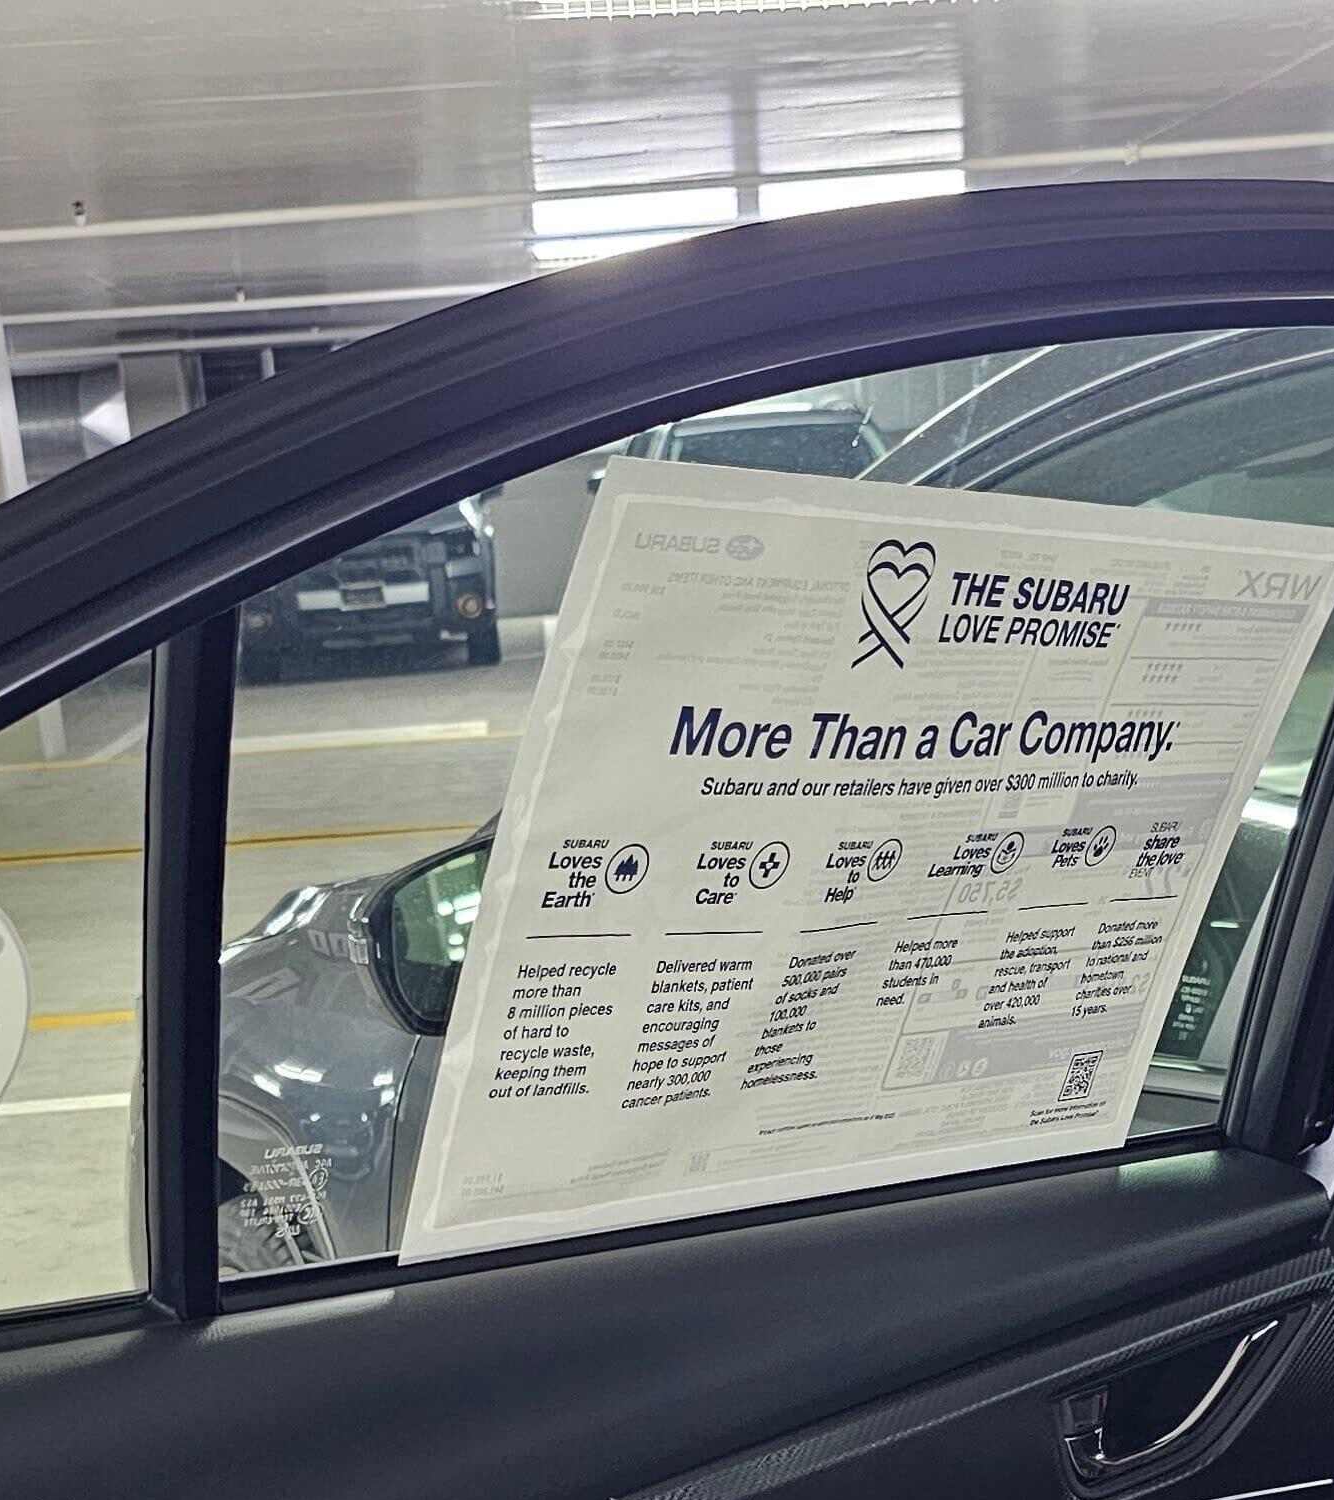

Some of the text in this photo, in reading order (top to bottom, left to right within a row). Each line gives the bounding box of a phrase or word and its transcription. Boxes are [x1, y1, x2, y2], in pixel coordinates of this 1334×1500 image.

[951, 572, 1010, 608] THE
[1013, 576, 1130, 616] SUBARU
[938, 613, 1116, 648] LOVE PROMISE
[669, 705, 1176, 763] More Than a Car Company.
[701, 769, 1138, 798] Subaru and our retailers have given over $300 million to charity.
[562, 839, 610, 850] SUBARU
[710, 840, 754, 851] SUBARU
[838, 840, 874, 851] SUBARU
[965, 832, 999, 844] SUBARU
[1050, 838, 1086, 855] Loves
[1143, 834, 1181, 851] share
[548, 851, 604, 870] Loves
[696, 853, 747, 870] Loves
[825, 853, 867, 869] Loves
[953, 845, 991, 861] Loves
[1051, 854, 1079, 868] Pets
[1135, 850, 1185, 868] the love
[847, 870, 860, 884] to
[927, 860, 984, 879] Learning
[568, 872, 597, 889] the
[723, 872, 740, 888] to
[541, 891, 592, 909] Earth
[695, 888, 735, 905] Care
[824, 885, 854, 904] Help
[1006, 926, 1076, 944] Helped support
[1097, 919, 1159, 934] Donated more
[894, 939, 958, 955] Helped more
[1091, 938, 1112, 951] than
[788, 950, 857, 970] Donated over
[1000, 948, 1015, 960] the
[1086, 956, 1095, 968] to
[1132, 949, 1150, 962] and
[517, 962, 617, 982] Helped recycle
[656, 958, 753, 974] Delivered warm
[888, 959, 912, 971] than
[994, 958, 1071, 978] rescue, transport
[821, 966, 848, 983] pairs
[882, 973, 939, 989] students in
[1080, 970, 1125, 985] hometown
[512, 984, 582, 1000] more than
[650, 977, 754, 994] blankets, patient
[988, 976, 1049, 994] and health of
[1113, 984, 1133, 996] over
[775, 983, 841, 1005] of socks and
[876, 993, 905, 1007] need.
[507, 1002, 614, 1020] 8 million pieces
[646, 997, 731, 1014] care kits, and
[983, 1000, 1005, 1012] over
[1071, 1005, 1082, 1017] 15
[503, 1024, 570, 1040] of hard to
[642, 1017, 720, 1034] encouraging
[761, 1019, 817, 1040] blankets to
[637, 1034, 716, 1053] messages of
[754, 1042, 783, 1057] those
[500, 1043, 595, 1063] recycle waste,
[632, 1051, 727, 1073] hope to support
[747, 1052, 814, 1074] experiencing
[494, 1064, 587, 1082] keeping them
[626, 1069, 712, 1091] nearly 300,000
[739, 1069, 818, 1090] homelessness.
[488, 1081, 590, 1099] out of landfills.
[621, 1087, 711, 1109] cancer patients.
